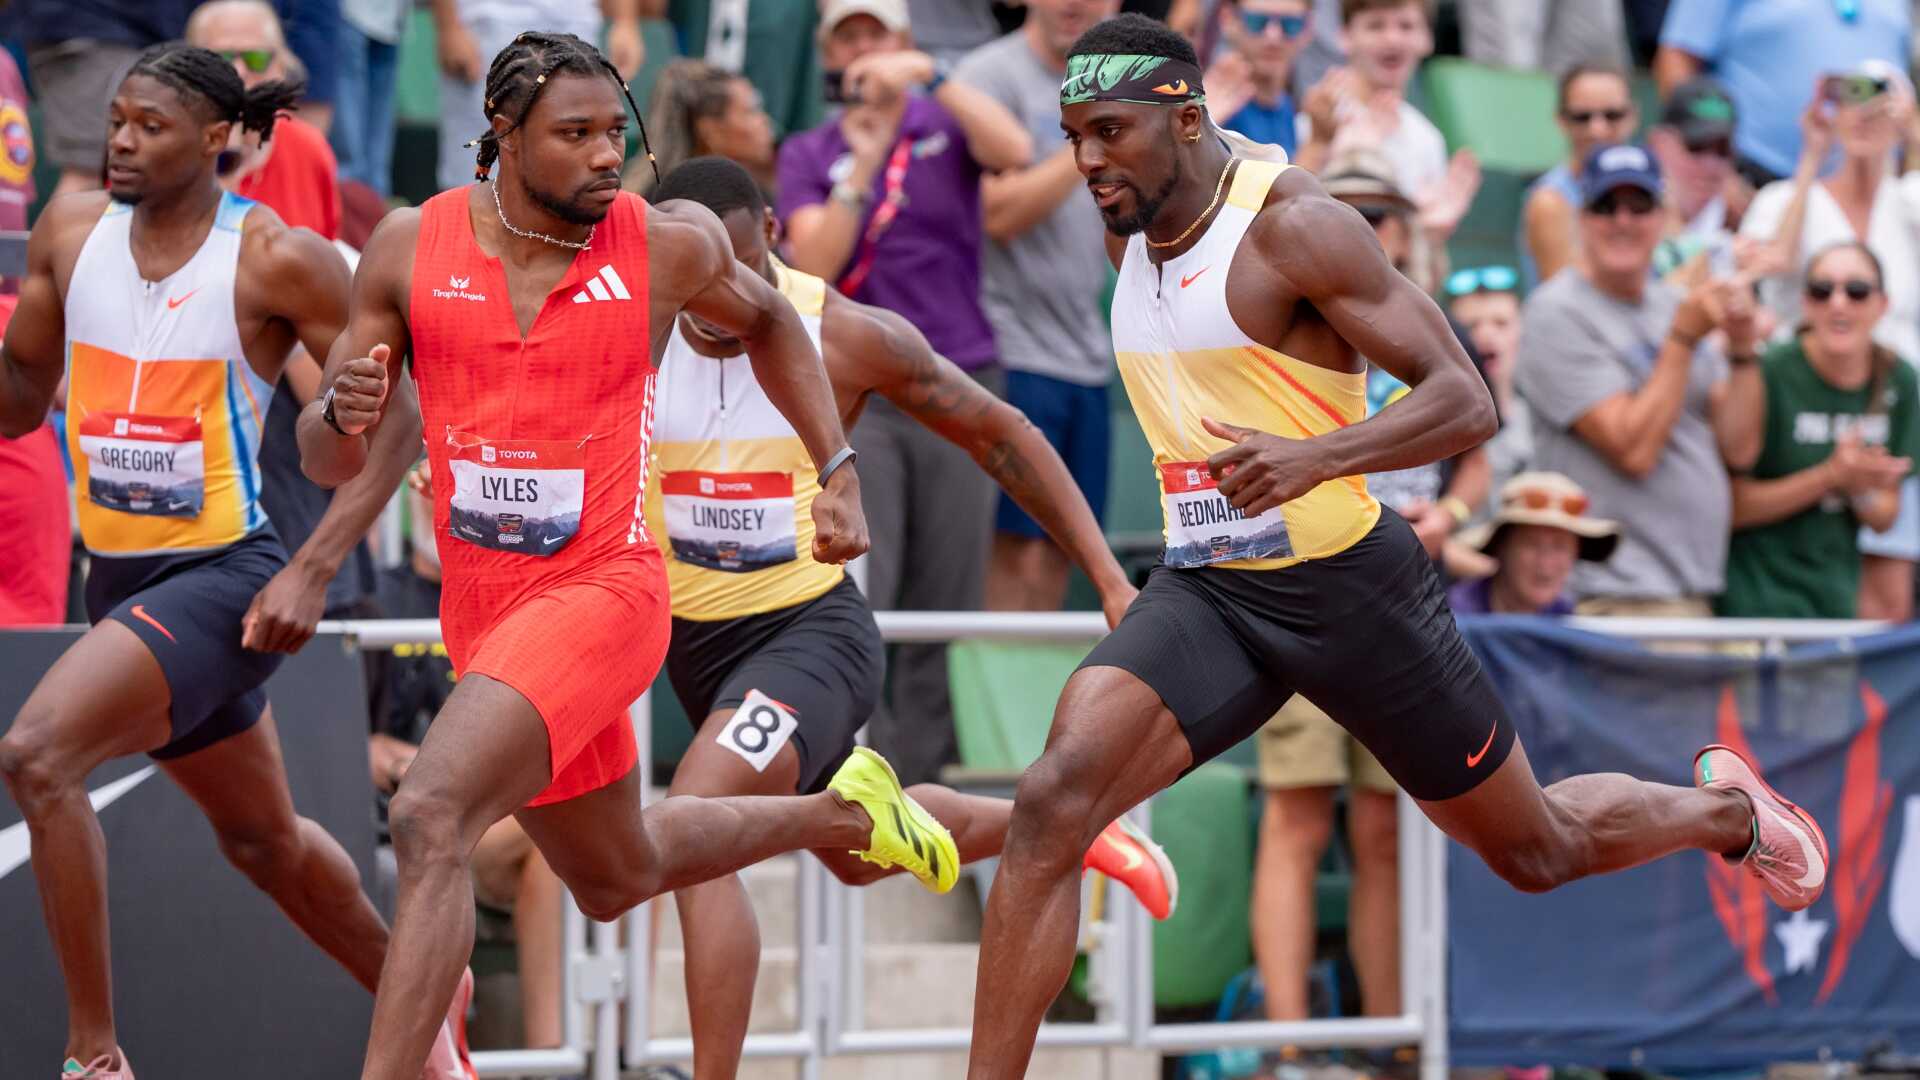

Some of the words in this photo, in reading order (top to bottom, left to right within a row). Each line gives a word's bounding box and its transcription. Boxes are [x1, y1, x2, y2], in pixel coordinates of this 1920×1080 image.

[101, 447, 175, 472] GREGORY
[499, 450, 537, 459] TOYOTA
[481, 475, 538, 502] LYLES
[693, 504, 765, 530] LINDSEY
[1177, 495, 1260, 527] BEDNAR
[732, 705, 780, 753] 8
